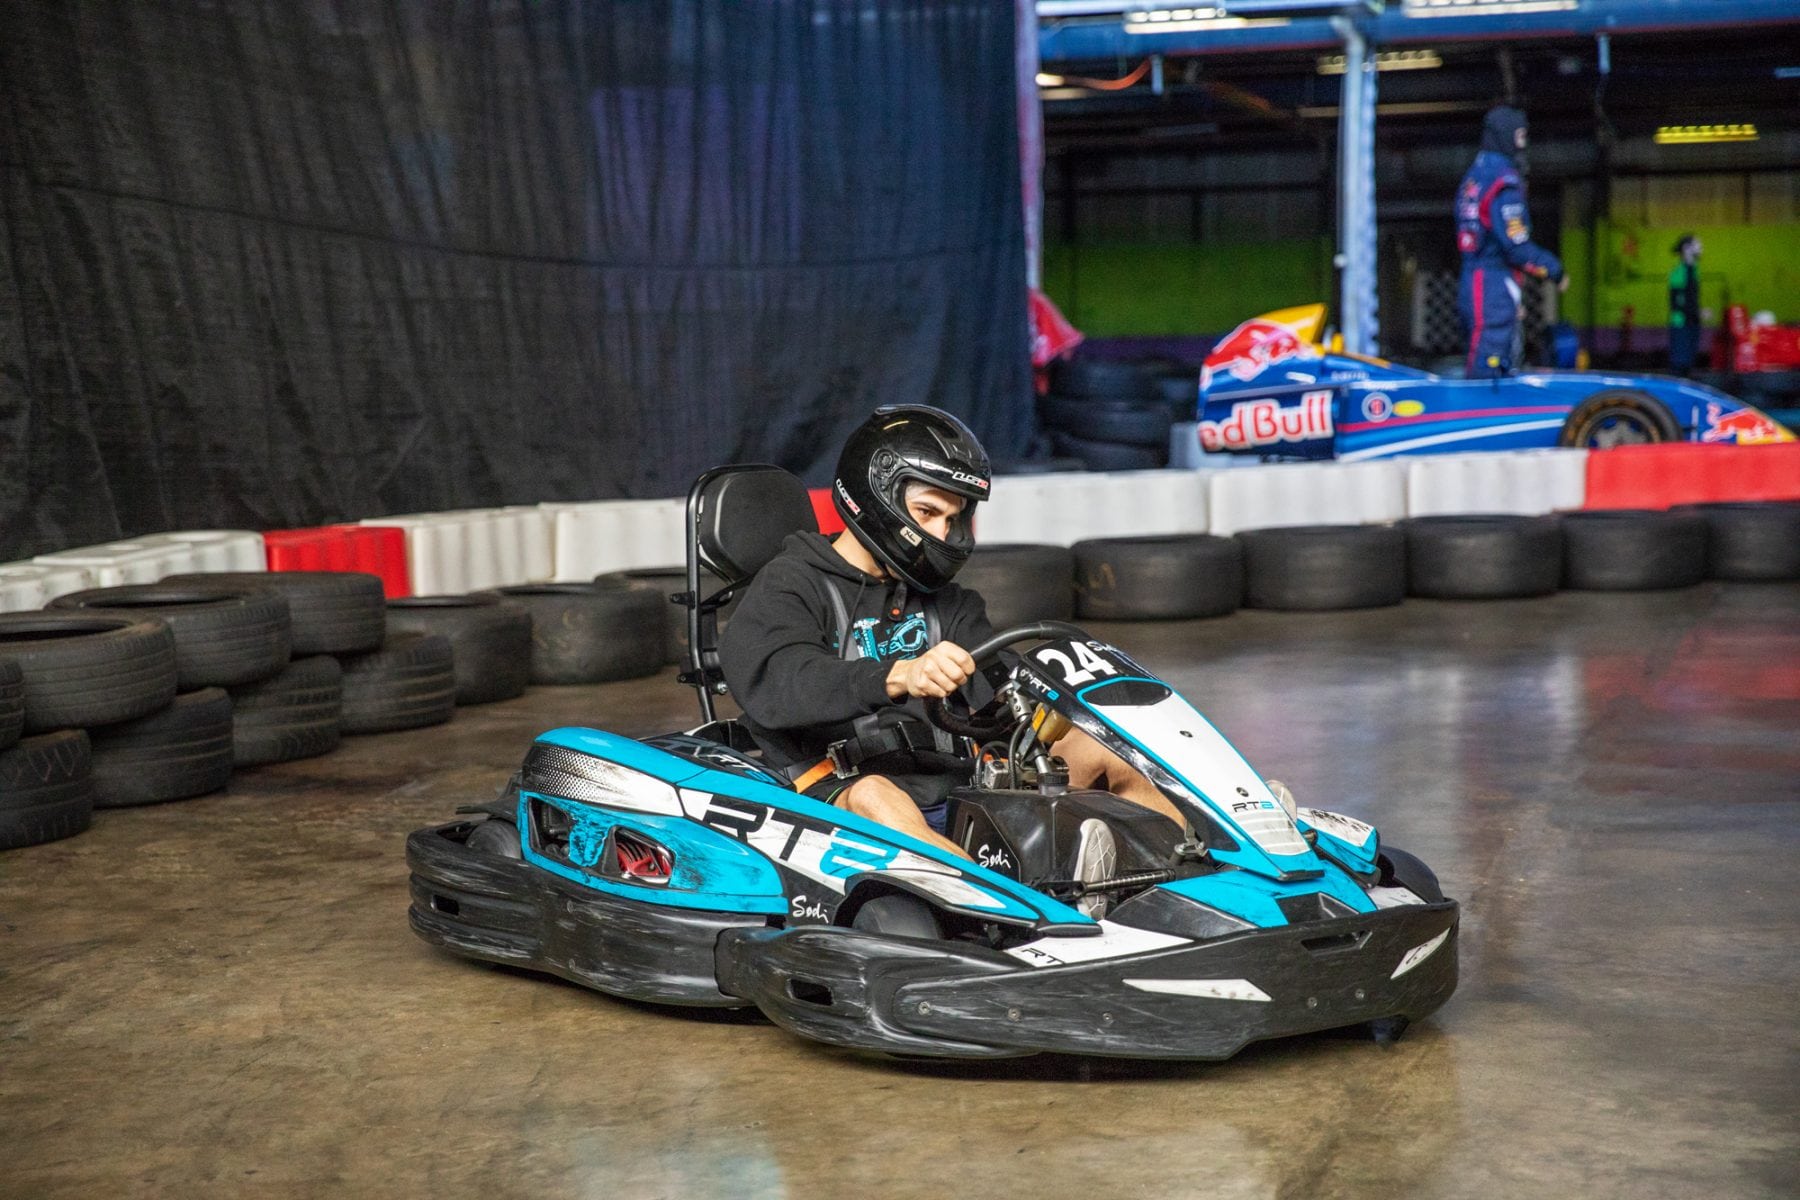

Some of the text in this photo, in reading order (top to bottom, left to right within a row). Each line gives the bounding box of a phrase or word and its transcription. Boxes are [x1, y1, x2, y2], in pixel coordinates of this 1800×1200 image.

[1198, 392, 1330, 450] ed Bull
[903, 529, 916, 542] XL
[1036, 641, 1118, 687] 24
[1029, 674, 1060, 701] RT8
[977, 844, 1011, 869] Sodi
[792, 895, 829, 923] Sodi
[1022, 947, 1063, 964] RT
